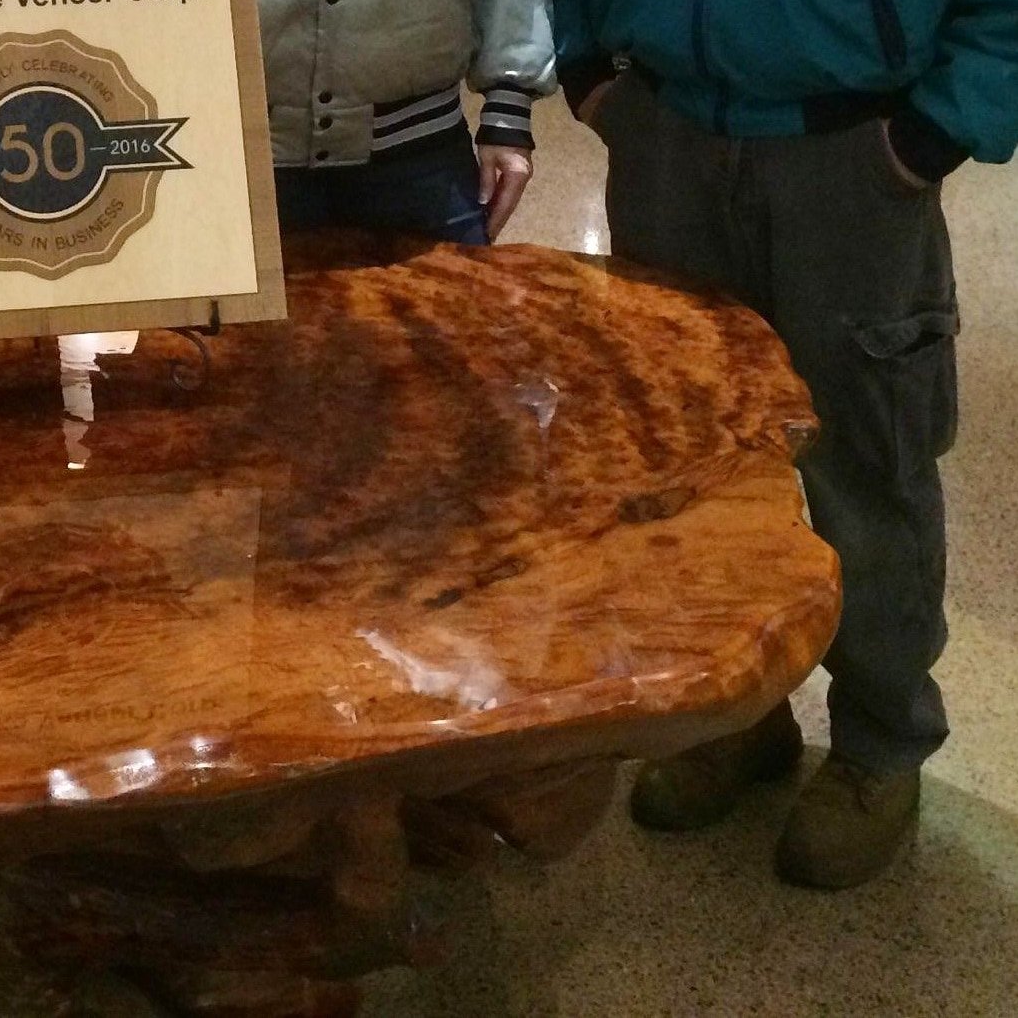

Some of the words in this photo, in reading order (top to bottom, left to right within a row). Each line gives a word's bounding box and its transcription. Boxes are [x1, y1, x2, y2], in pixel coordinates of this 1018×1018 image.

[22, 59, 115, 102] CELEBRATING
[0, 121, 87, 184] 50
[110, 138, 151, 155] 2016
[31, 237, 48, 250] IN
[55, 198, 125, 250] BUSINESS
